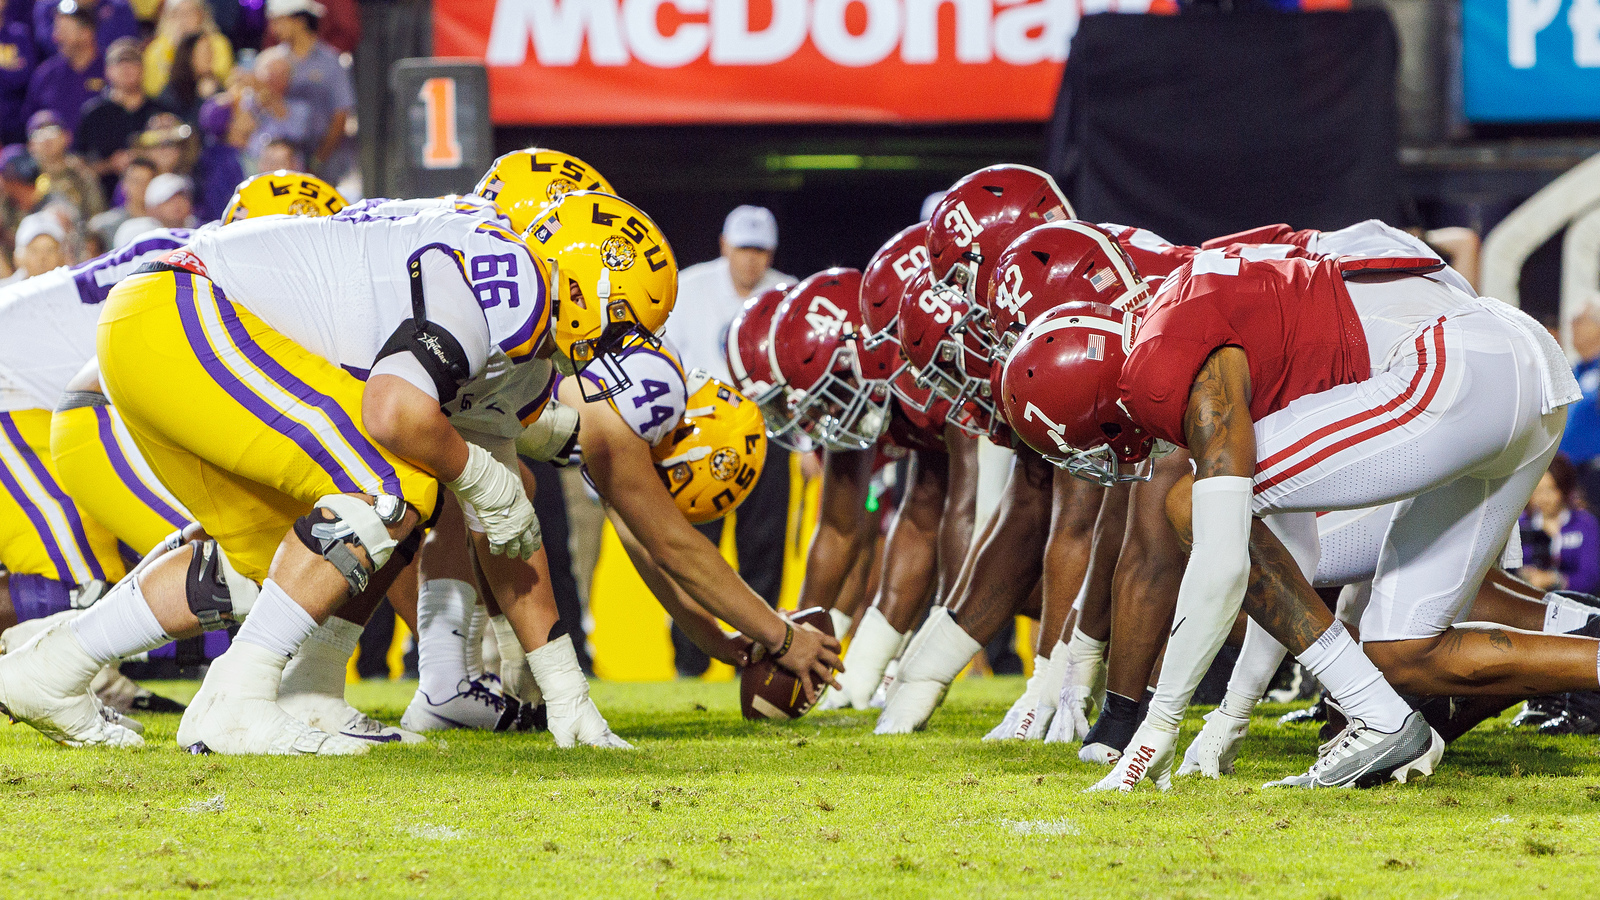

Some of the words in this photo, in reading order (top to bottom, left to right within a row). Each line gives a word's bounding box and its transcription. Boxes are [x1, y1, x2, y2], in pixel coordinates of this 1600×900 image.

[487, 0, 1150, 67] McDona
[419, 77, 462, 170] 1
[592, 203, 668, 273] LSU
[944, 201, 984, 248] 31
[470, 252, 520, 310] 66
[995, 264, 1033, 316] 42
[804, 295, 849, 334] 47
[632, 378, 674, 435] 44
[1023, 401, 1066, 435] 7
[712, 433, 761, 511] LSU
